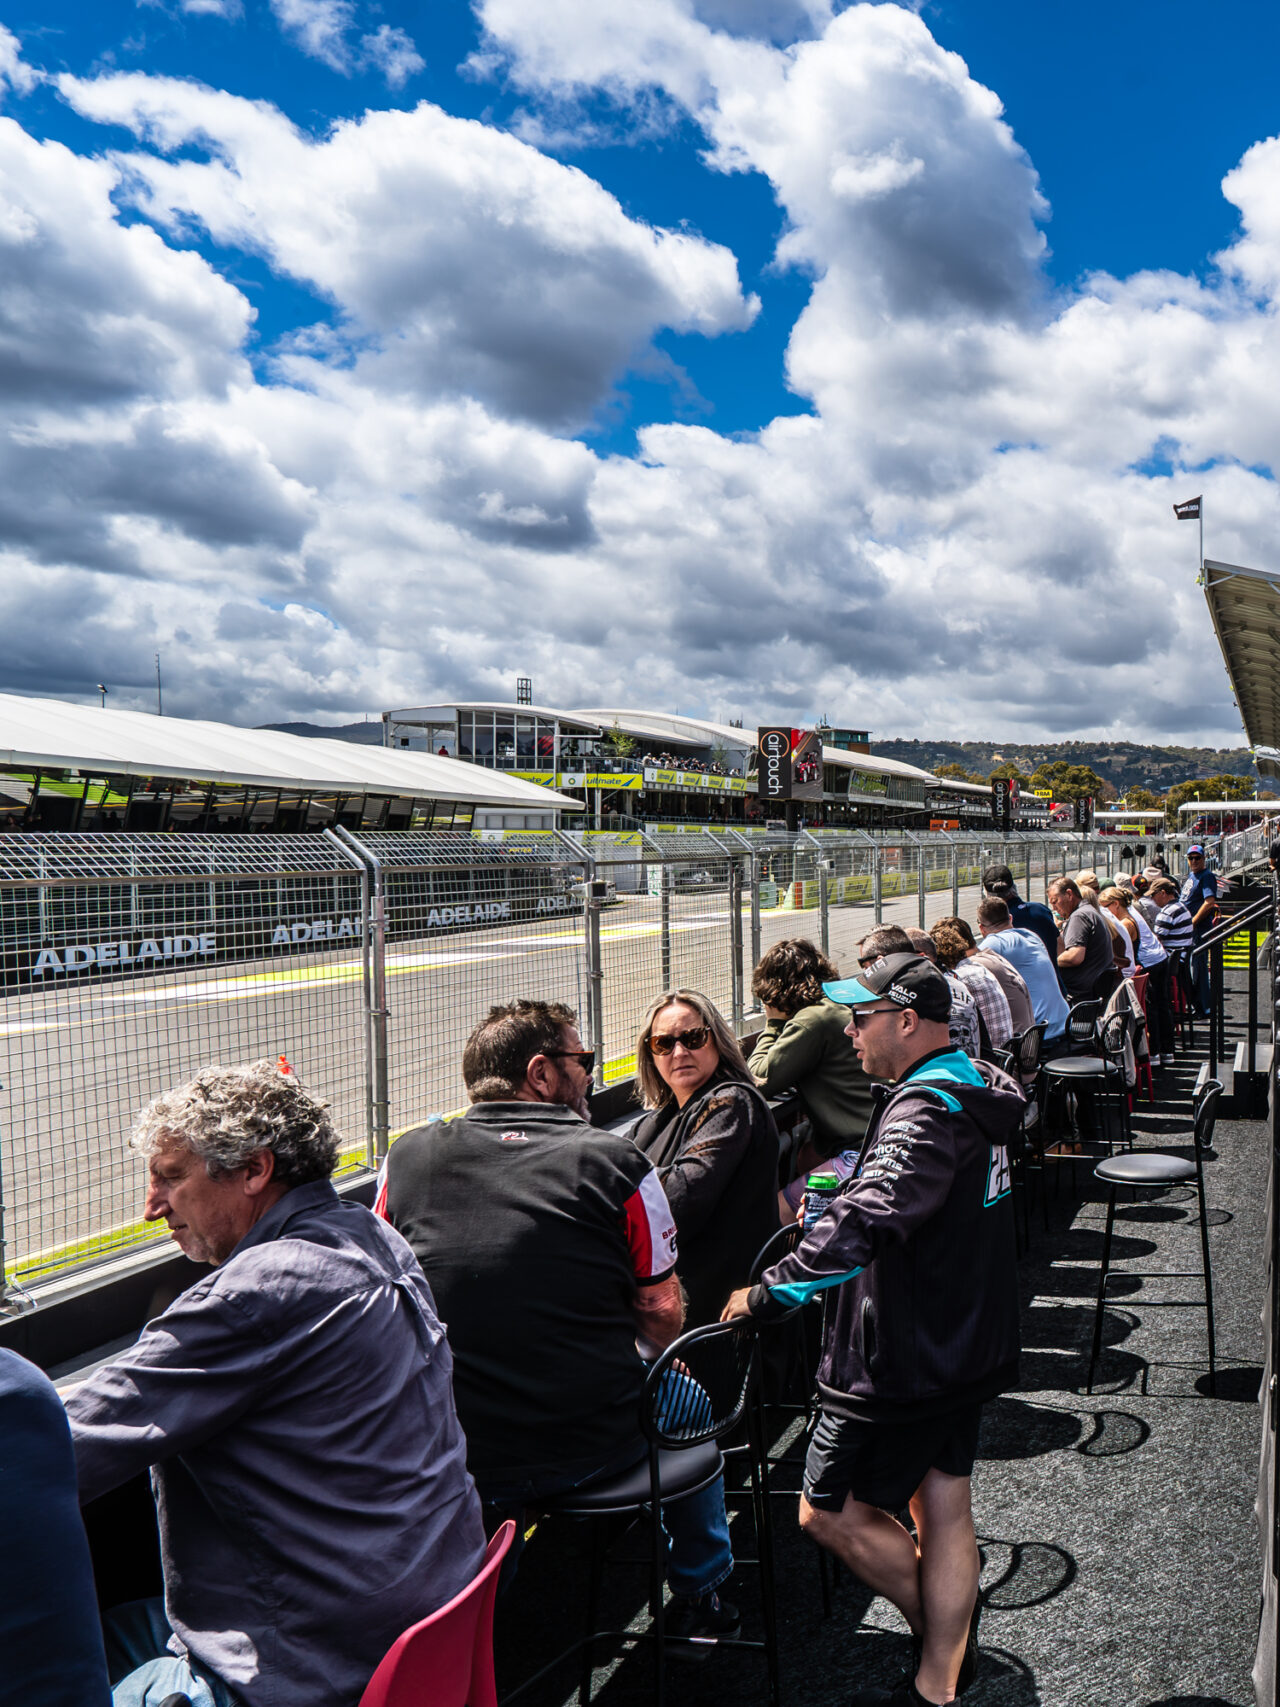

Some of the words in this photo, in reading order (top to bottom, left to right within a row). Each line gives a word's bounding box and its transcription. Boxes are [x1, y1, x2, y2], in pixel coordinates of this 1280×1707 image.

[768, 734, 783, 795] airtouch
[587, 776, 622, 785] ultimate
[427, 902, 510, 927] ADELAIDE
[272, 914, 390, 944] ADELAIE
[33, 932, 217, 976] ADELAIDE
[891, 982, 918, 1000] VALO
